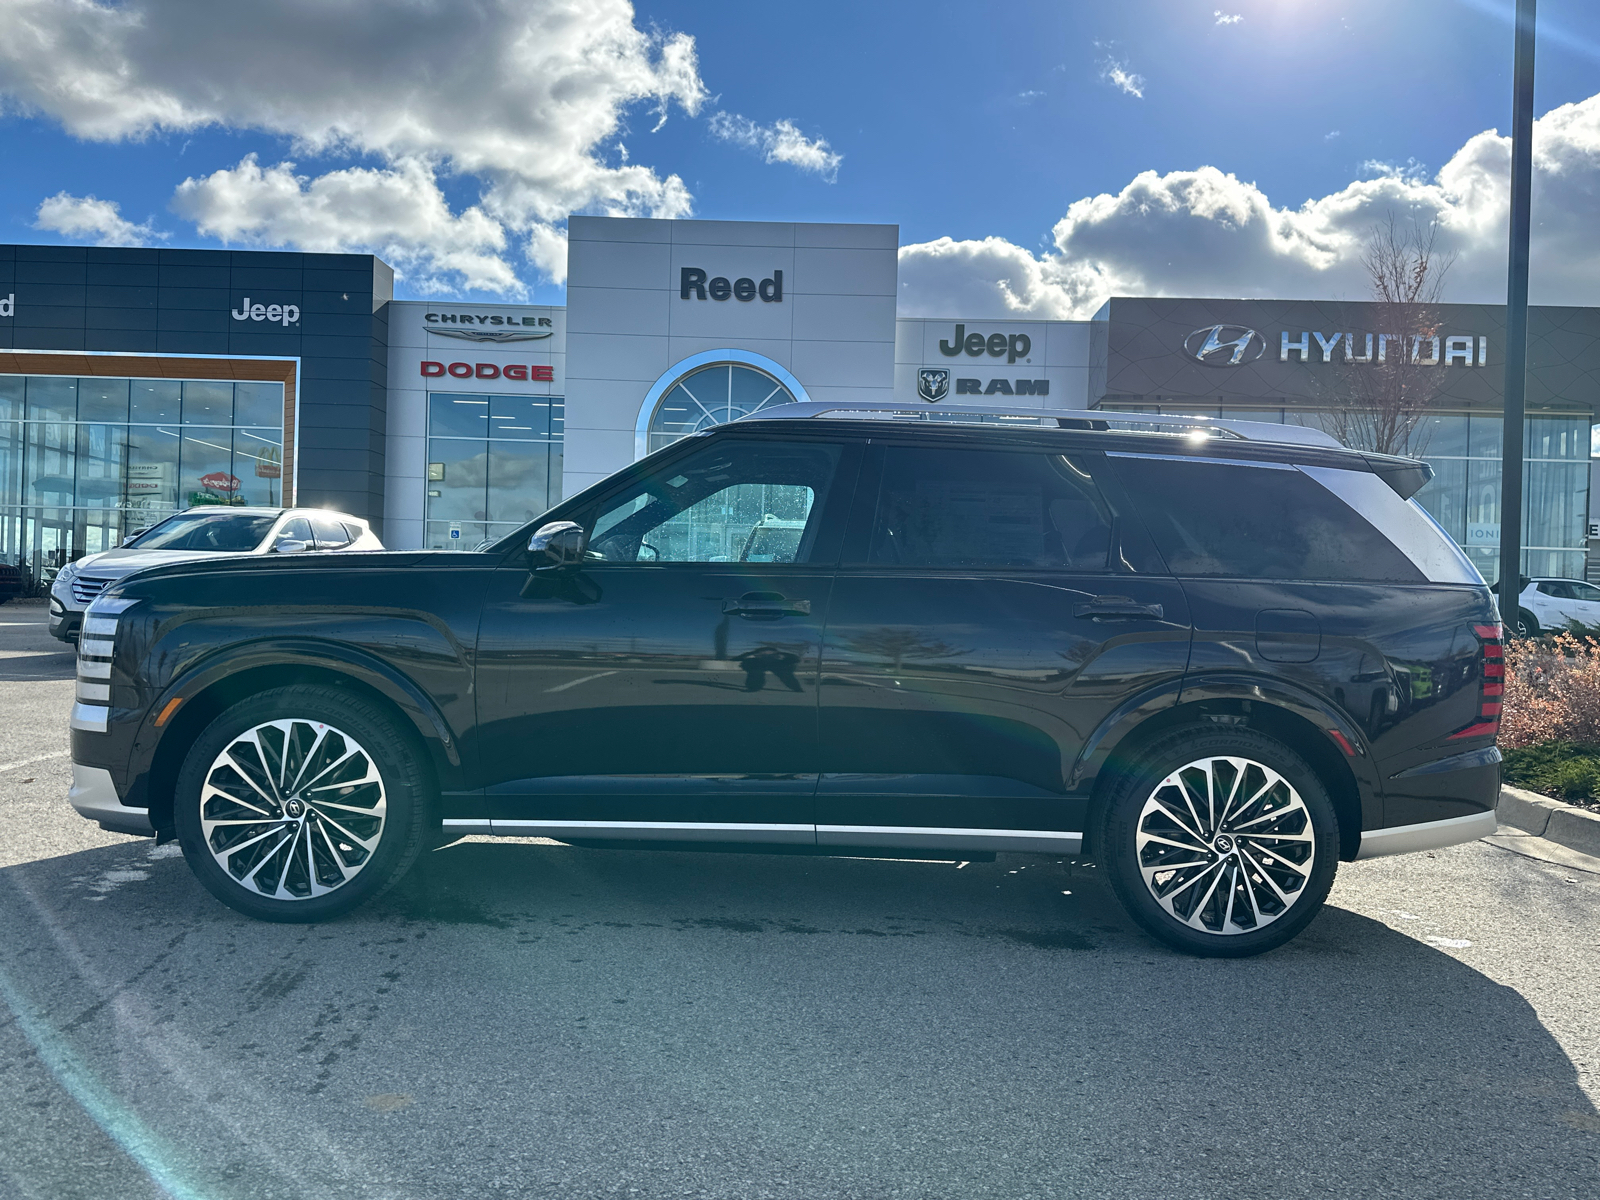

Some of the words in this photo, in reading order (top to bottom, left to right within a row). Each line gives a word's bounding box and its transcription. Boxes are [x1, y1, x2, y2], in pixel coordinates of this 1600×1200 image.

[680, 267, 783, 302] Reed
[232, 297, 300, 327] Jeep
[424, 313, 552, 327] CHRYSLER
[939, 324, 1031, 364] Jeep
[1279, 331, 1487, 367] HYUNDAI
[420, 361, 554, 381] DODGE
[955, 378, 1050, 395] RAM
[1470, 529, 1500, 539] IONI
